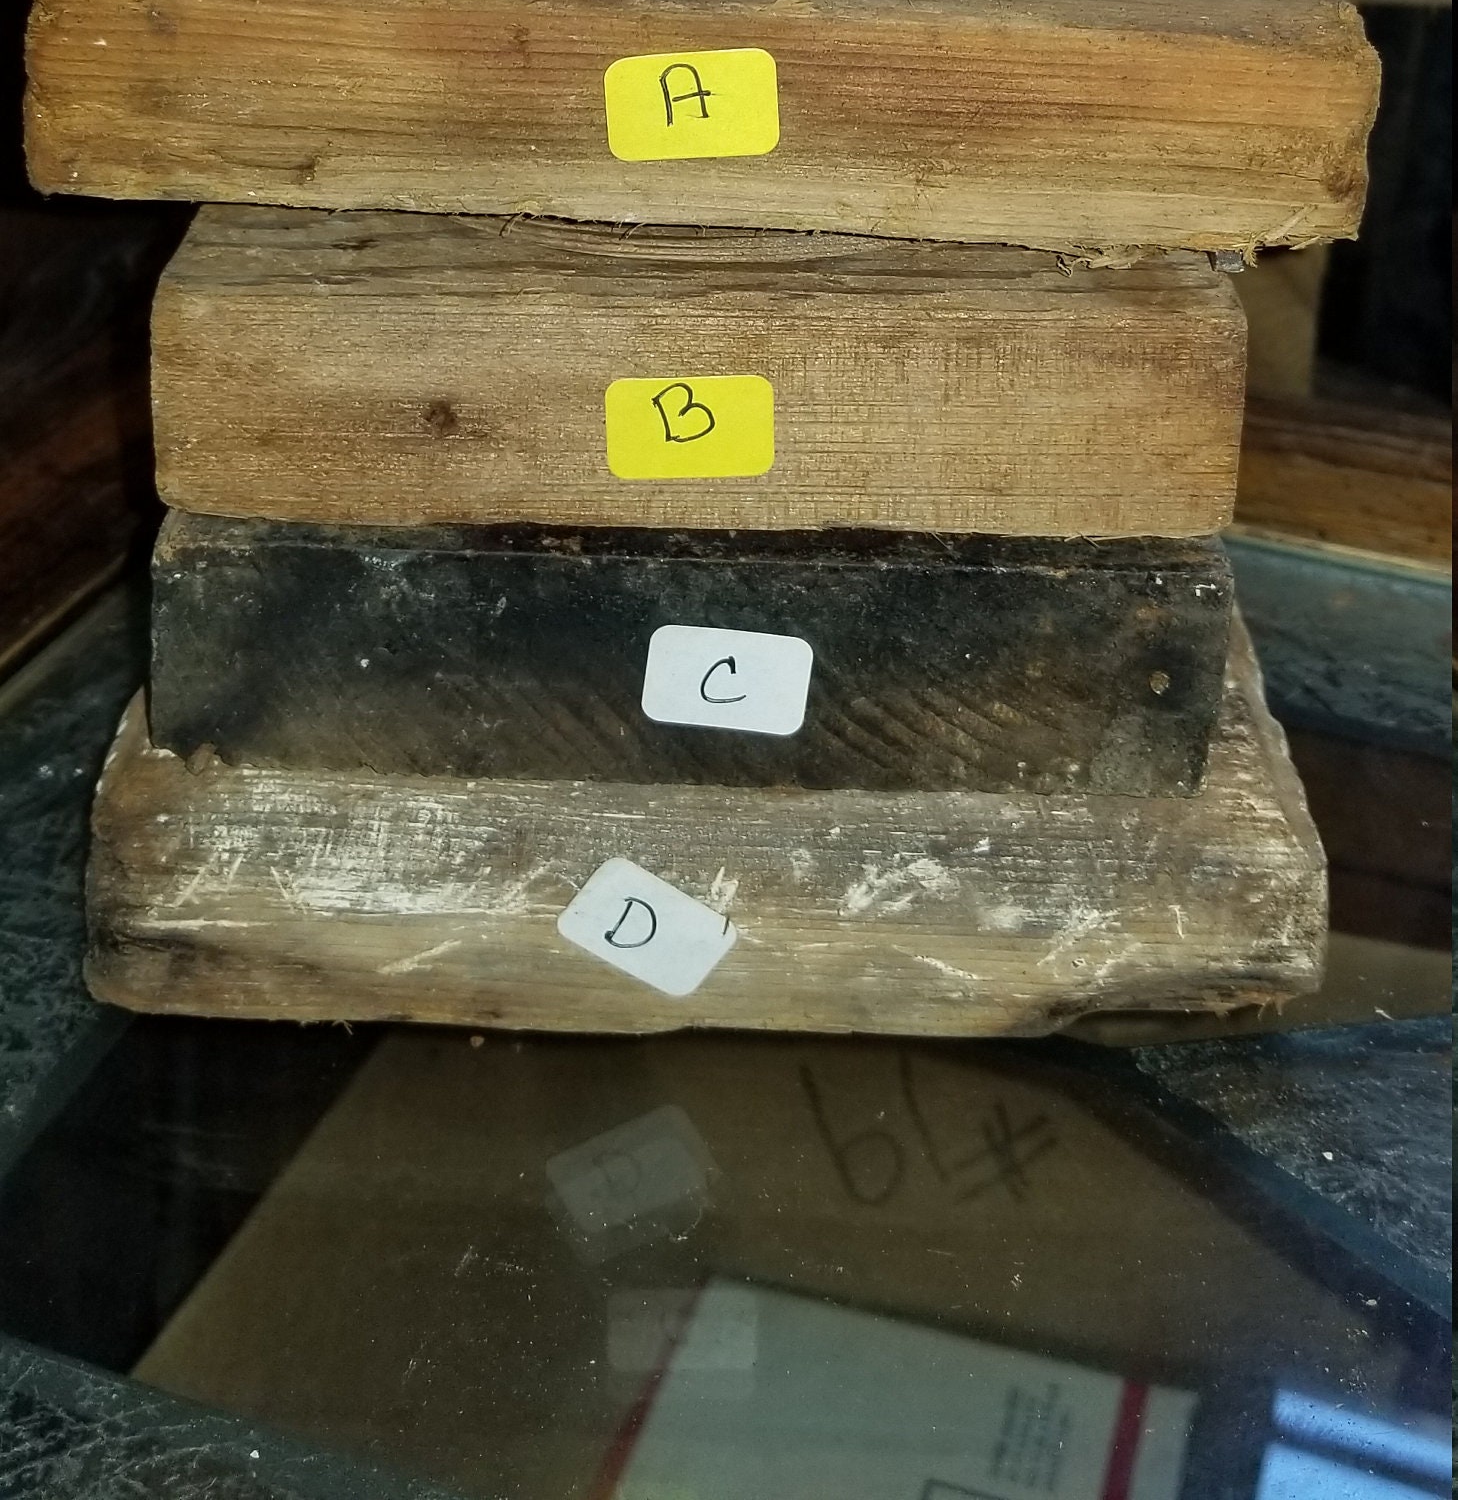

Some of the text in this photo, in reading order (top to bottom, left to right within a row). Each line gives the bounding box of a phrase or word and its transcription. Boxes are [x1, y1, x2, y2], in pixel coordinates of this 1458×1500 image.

[659, 62, 712, 127] A
[650, 382, 716, 443] B
[699, 655, 747, 704] C
[604, 896, 657, 949] D
